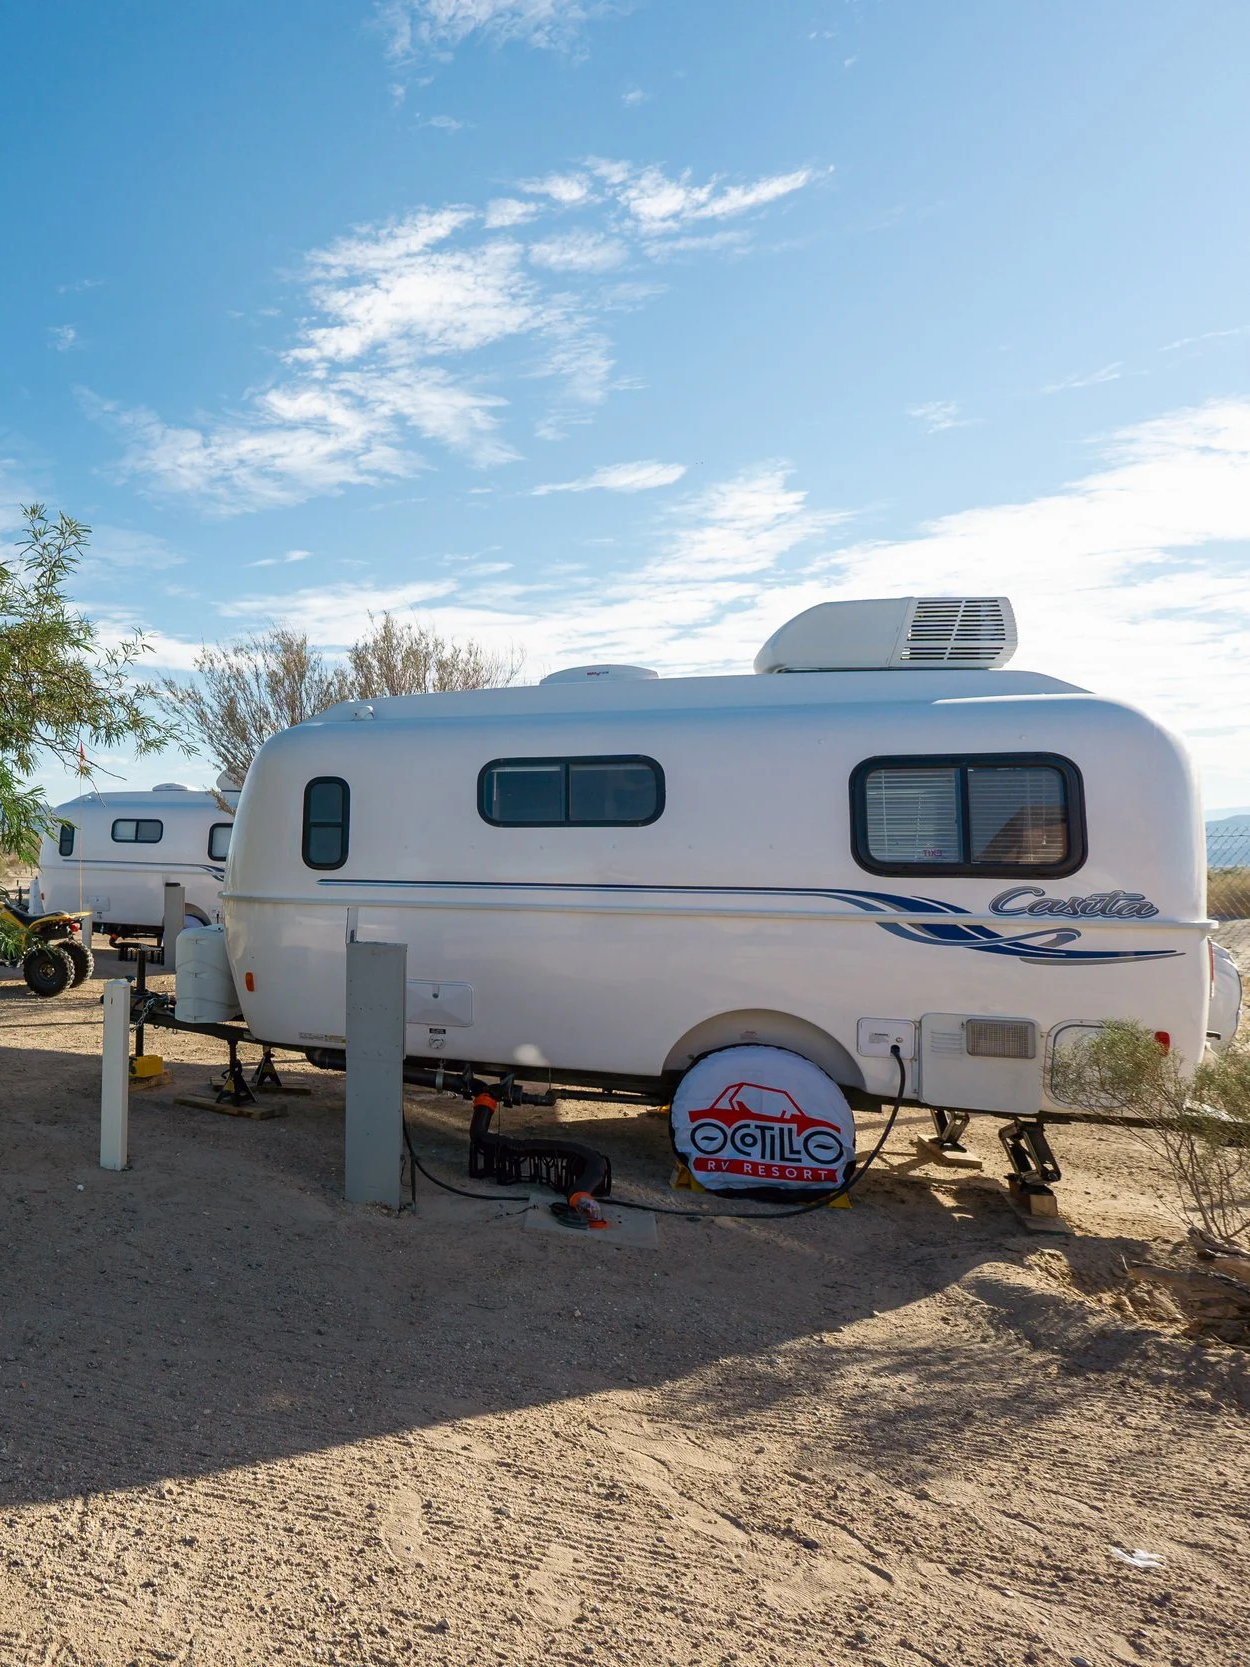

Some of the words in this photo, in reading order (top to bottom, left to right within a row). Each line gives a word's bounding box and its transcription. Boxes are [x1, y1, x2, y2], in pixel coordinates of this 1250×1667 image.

[989, 885, 1159, 919] Casita
[690, 1122, 844, 1165] OCOTILLO
[707, 1160, 730, 1171] RV
[743, 1162, 828, 1181] RESORT
